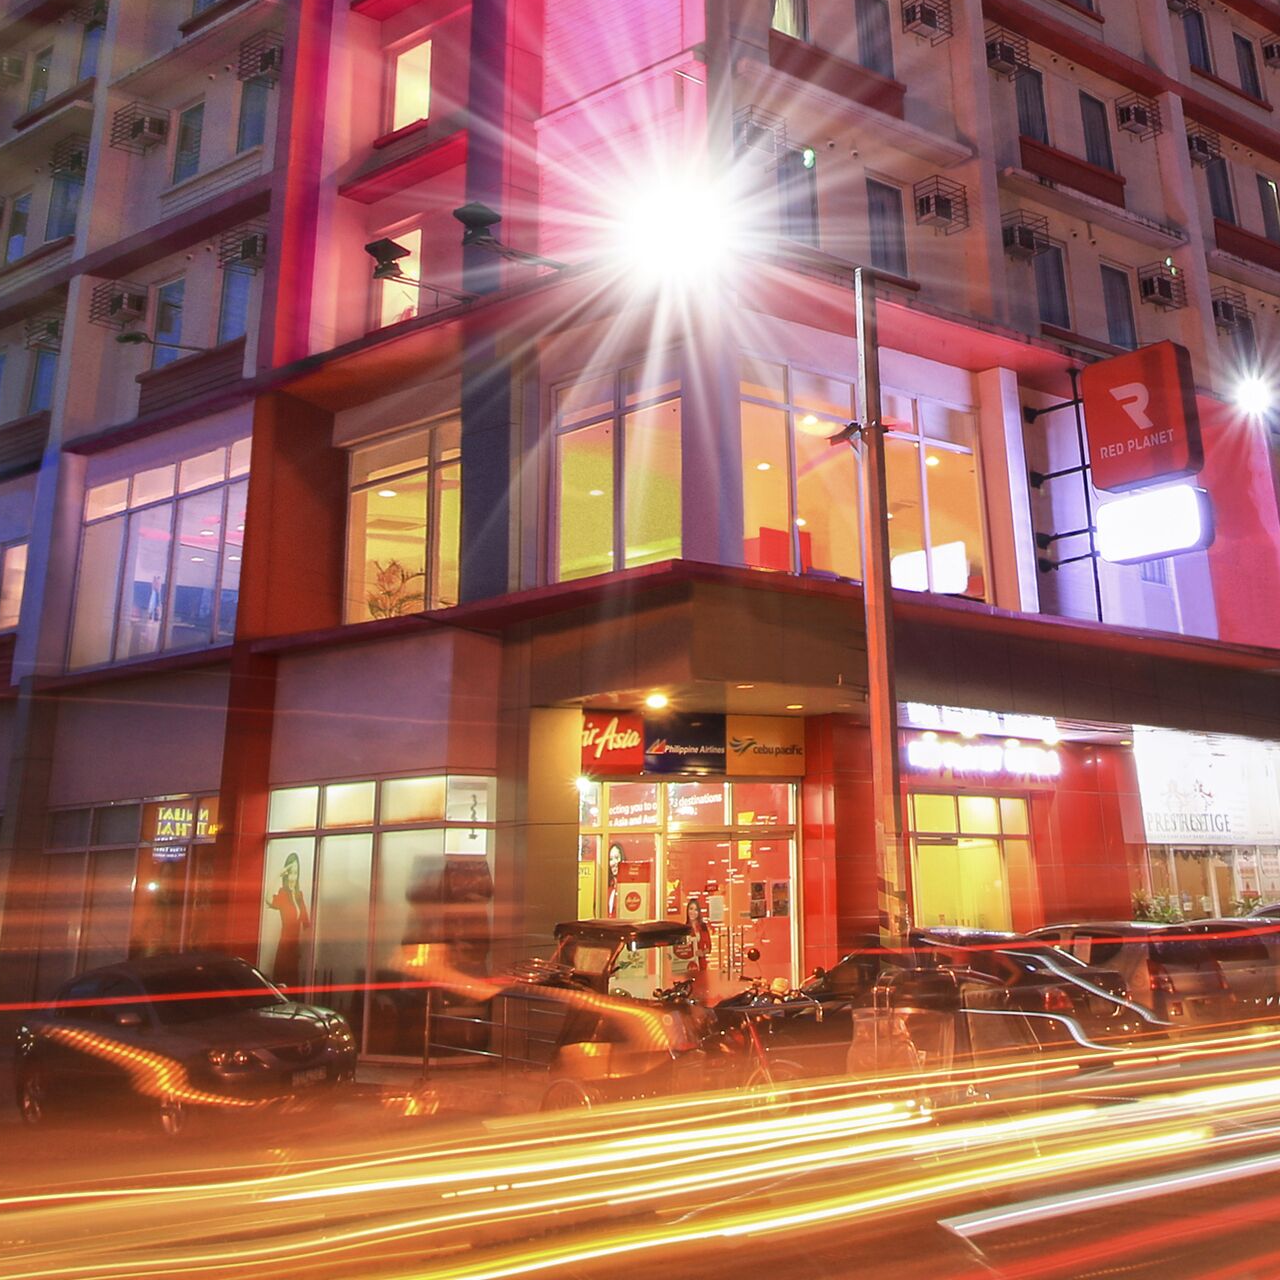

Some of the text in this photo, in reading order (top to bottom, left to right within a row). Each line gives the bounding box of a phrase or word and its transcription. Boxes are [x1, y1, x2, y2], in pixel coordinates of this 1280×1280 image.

[1100, 428, 1174, 459] RED PLANET
[664, 743, 726, 755] Philippine Airlines
[753, 744, 804, 756] cebu pacific
[630, 804, 643, 815] you
[678, 793, 723, 806] destinations
